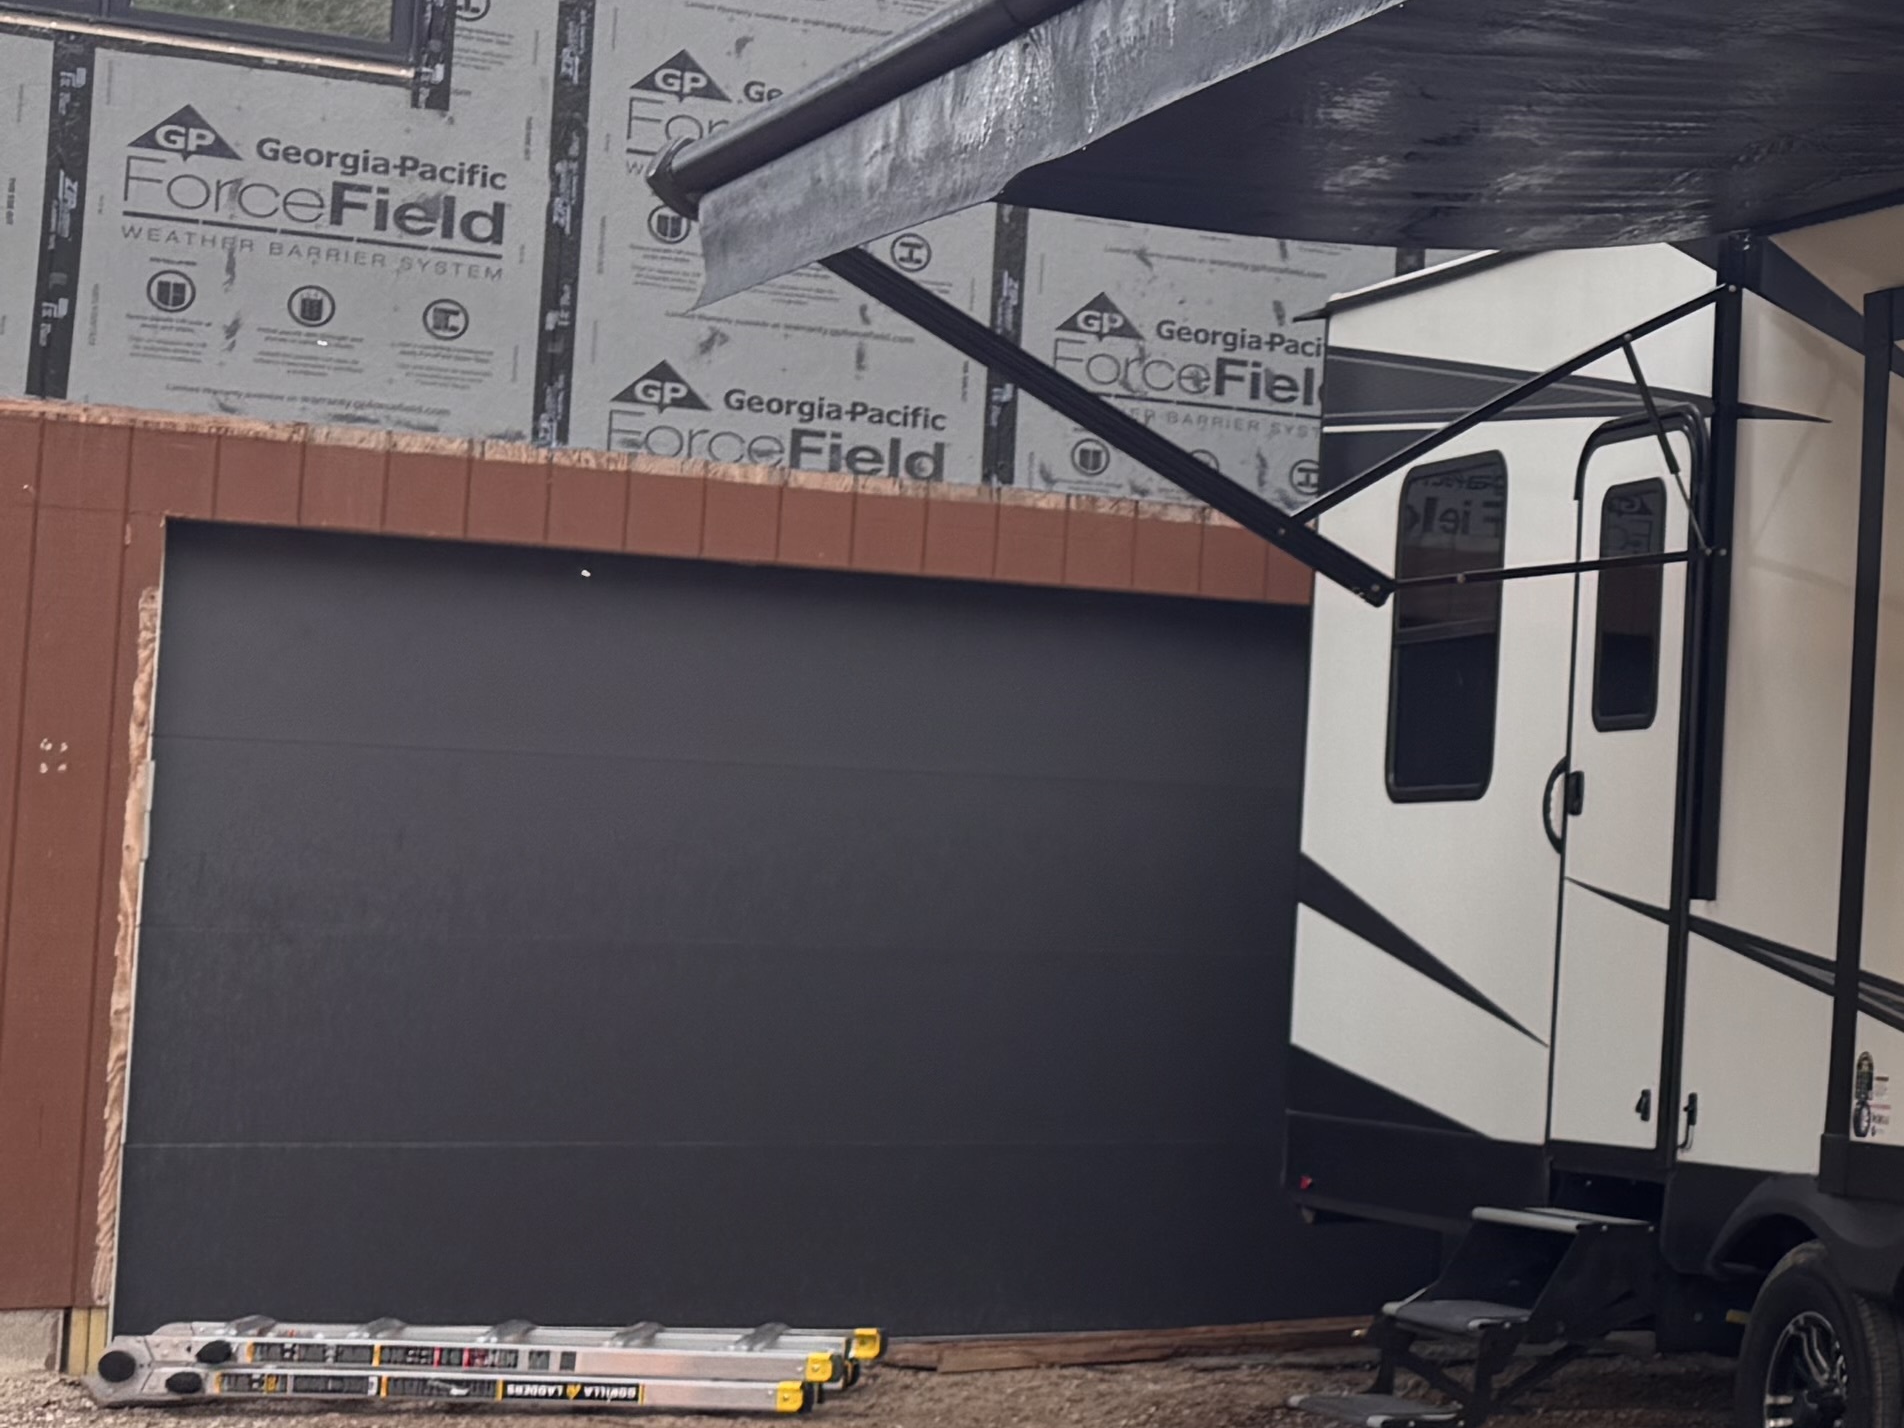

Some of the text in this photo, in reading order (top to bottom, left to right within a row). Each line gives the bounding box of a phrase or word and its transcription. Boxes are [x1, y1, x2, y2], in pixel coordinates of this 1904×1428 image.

[655, 69, 707, 92] GP
[155, 125, 216, 152] GP
[256, 137, 507, 191] Georgia-Pacific
[124, 155, 505, 246] ForceField
[121, 225, 503, 282] WEATHER BARRIER SYSTEM
[1076, 310, 1123, 332] GP
[634, 380, 688, 403] GP
[1054, 338, 1323, 406] ForceFiel
[724, 389, 947, 430] Georgia-Pacific
[1168, 411, 1259, 432] BARRIER
[608, 410, 945, 482] ForceField
